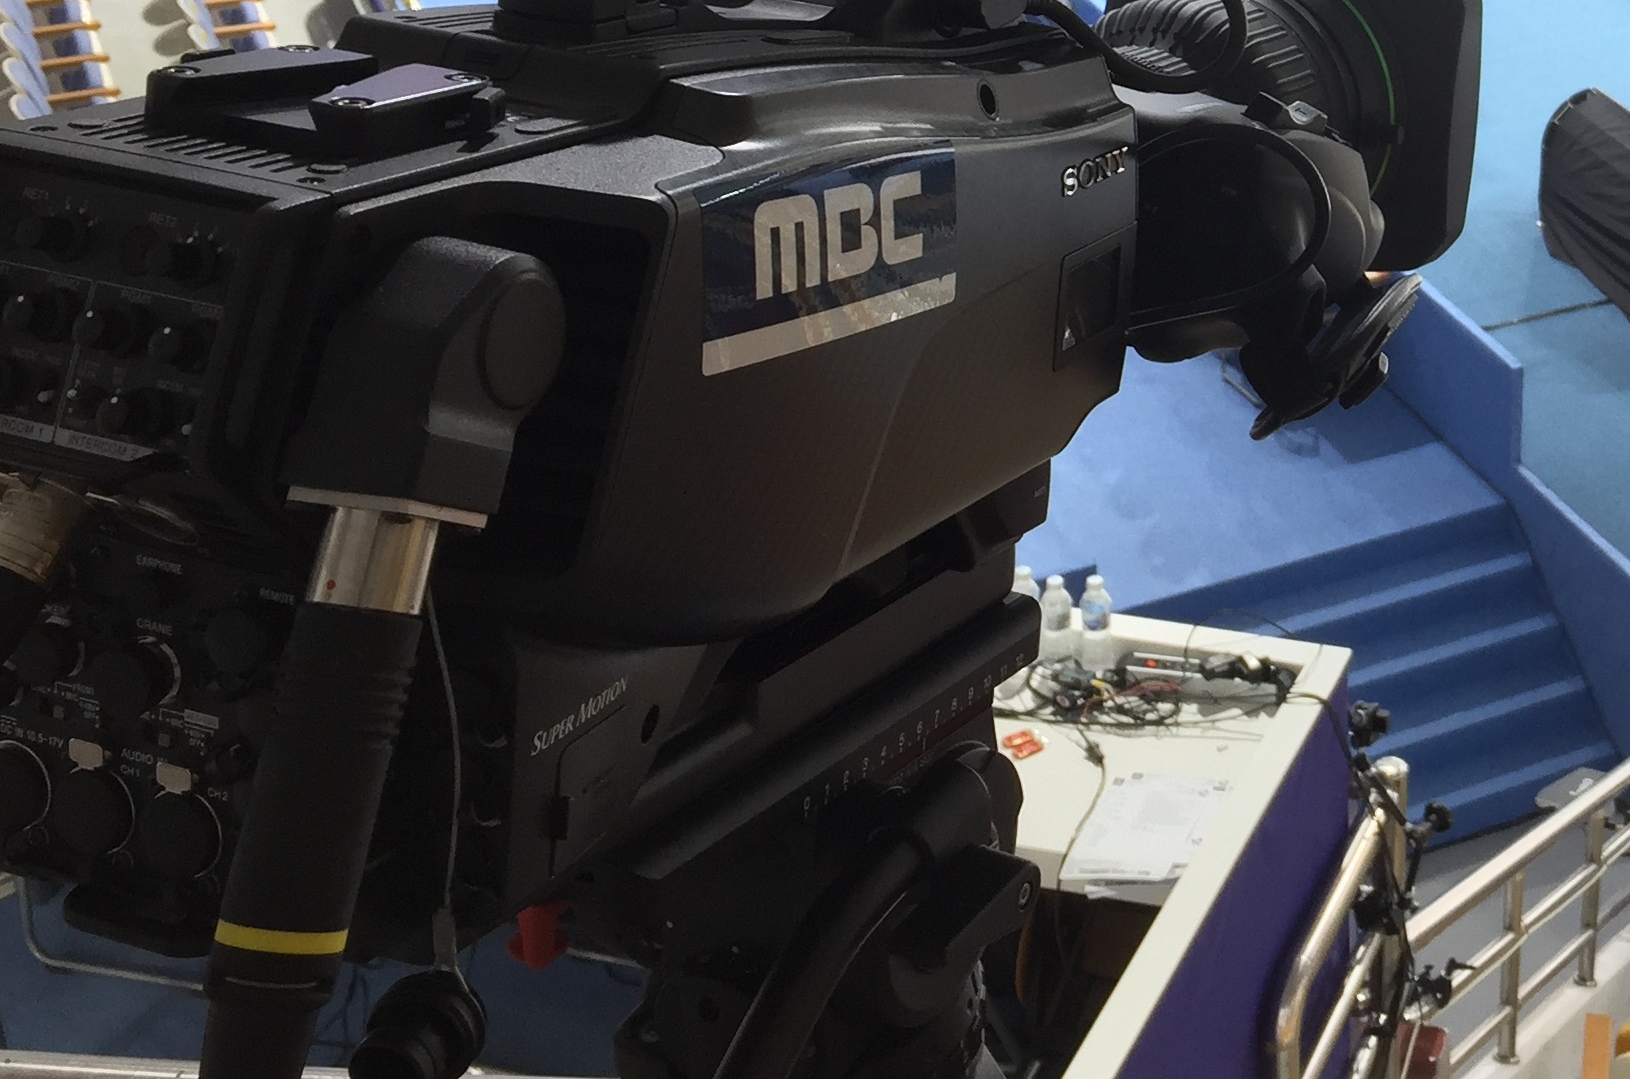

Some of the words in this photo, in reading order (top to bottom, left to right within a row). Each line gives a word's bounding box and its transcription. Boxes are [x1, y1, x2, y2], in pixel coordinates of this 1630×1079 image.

[1062, 145, 1129, 198] SONY
[753, 170, 924, 301] MBC
[136, 554, 183, 575] EARPHONE
[136, 617, 173, 636] CRANE
[120, 747, 154, 765] AUDIO
